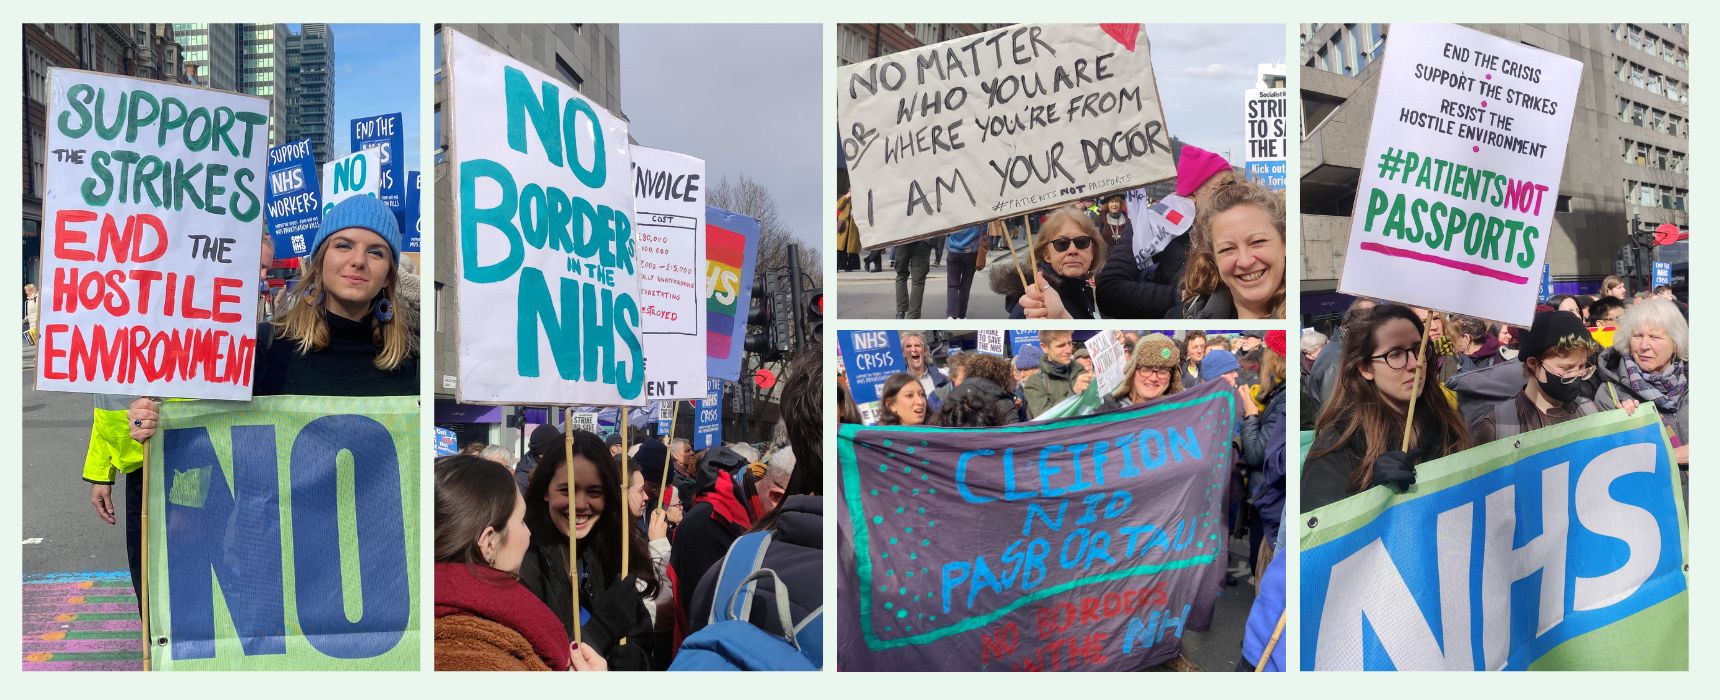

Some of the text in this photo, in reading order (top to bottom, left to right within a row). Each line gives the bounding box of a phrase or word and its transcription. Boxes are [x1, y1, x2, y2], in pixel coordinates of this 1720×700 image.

[849, 25, 1056, 99] NO MATTER
[1443, 42, 1542, 84] END THE CRISIS
[896, 52, 1115, 125] WHO YOU ARE
[1415, 63, 1558, 116] SUPPORT THE STRIKES
[57, 83, 268, 159] SUPPORT
[356, 116, 395, 140] END THE
[504, 65, 607, 189] NO
[842, 85, 1143, 165] OR WHERE YOU'RE FROM
[1248, 119, 1268, 138] TO
[1399, 107, 1547, 159] HOSTILE ENVIRONMENT
[1440, 98, 1514, 132] RESIST THE
[270, 139, 310, 165] SUPPORT
[1248, 139, 1277, 158] THE
[1251, 163, 1285, 174] Kick out
[52, 148, 261, 223] THE STRIKES
[271, 168, 303, 194] NHS
[333, 153, 367, 195] NO
[632, 162, 700, 202] NVOICE
[867, 120, 1171, 228] I AM YOUR DOCTOR
[992, 174, 1132, 212] #PATIENTS NOT PASSPORTS
[267, 191, 318, 218] WORKERS
[460, 159, 635, 283] BORDERS
[652, 215, 674, 224] COST
[53, 210, 237, 264] END THE
[1363, 187, 1540, 269] PASSPORTS
[567, 256, 615, 287] IN THE
[706, 260, 738, 306] HS
[52, 267, 244, 324] HOSTILE
[641, 289, 680, 300] EVASTATING
[641, 305, 678, 321] ESTROYED
[43, 323, 257, 387] ENVIRONMENT
[517, 267, 645, 400] NHS
[854, 331, 887, 351] NHS
[978, 342, 1002, 353] THE NHS
[979, 334, 1002, 345] TO SAVE
[856, 351, 894, 370] CRISIS
[647, 381, 678, 396] ENT
[955, 425, 1203, 504] CLEIFION
[1022, 490, 1134, 536] NID
[164, 414, 410, 660] NO
[1314, 442, 1661, 671] NHS
[981, 581, 1169, 664] NO BORDERS
